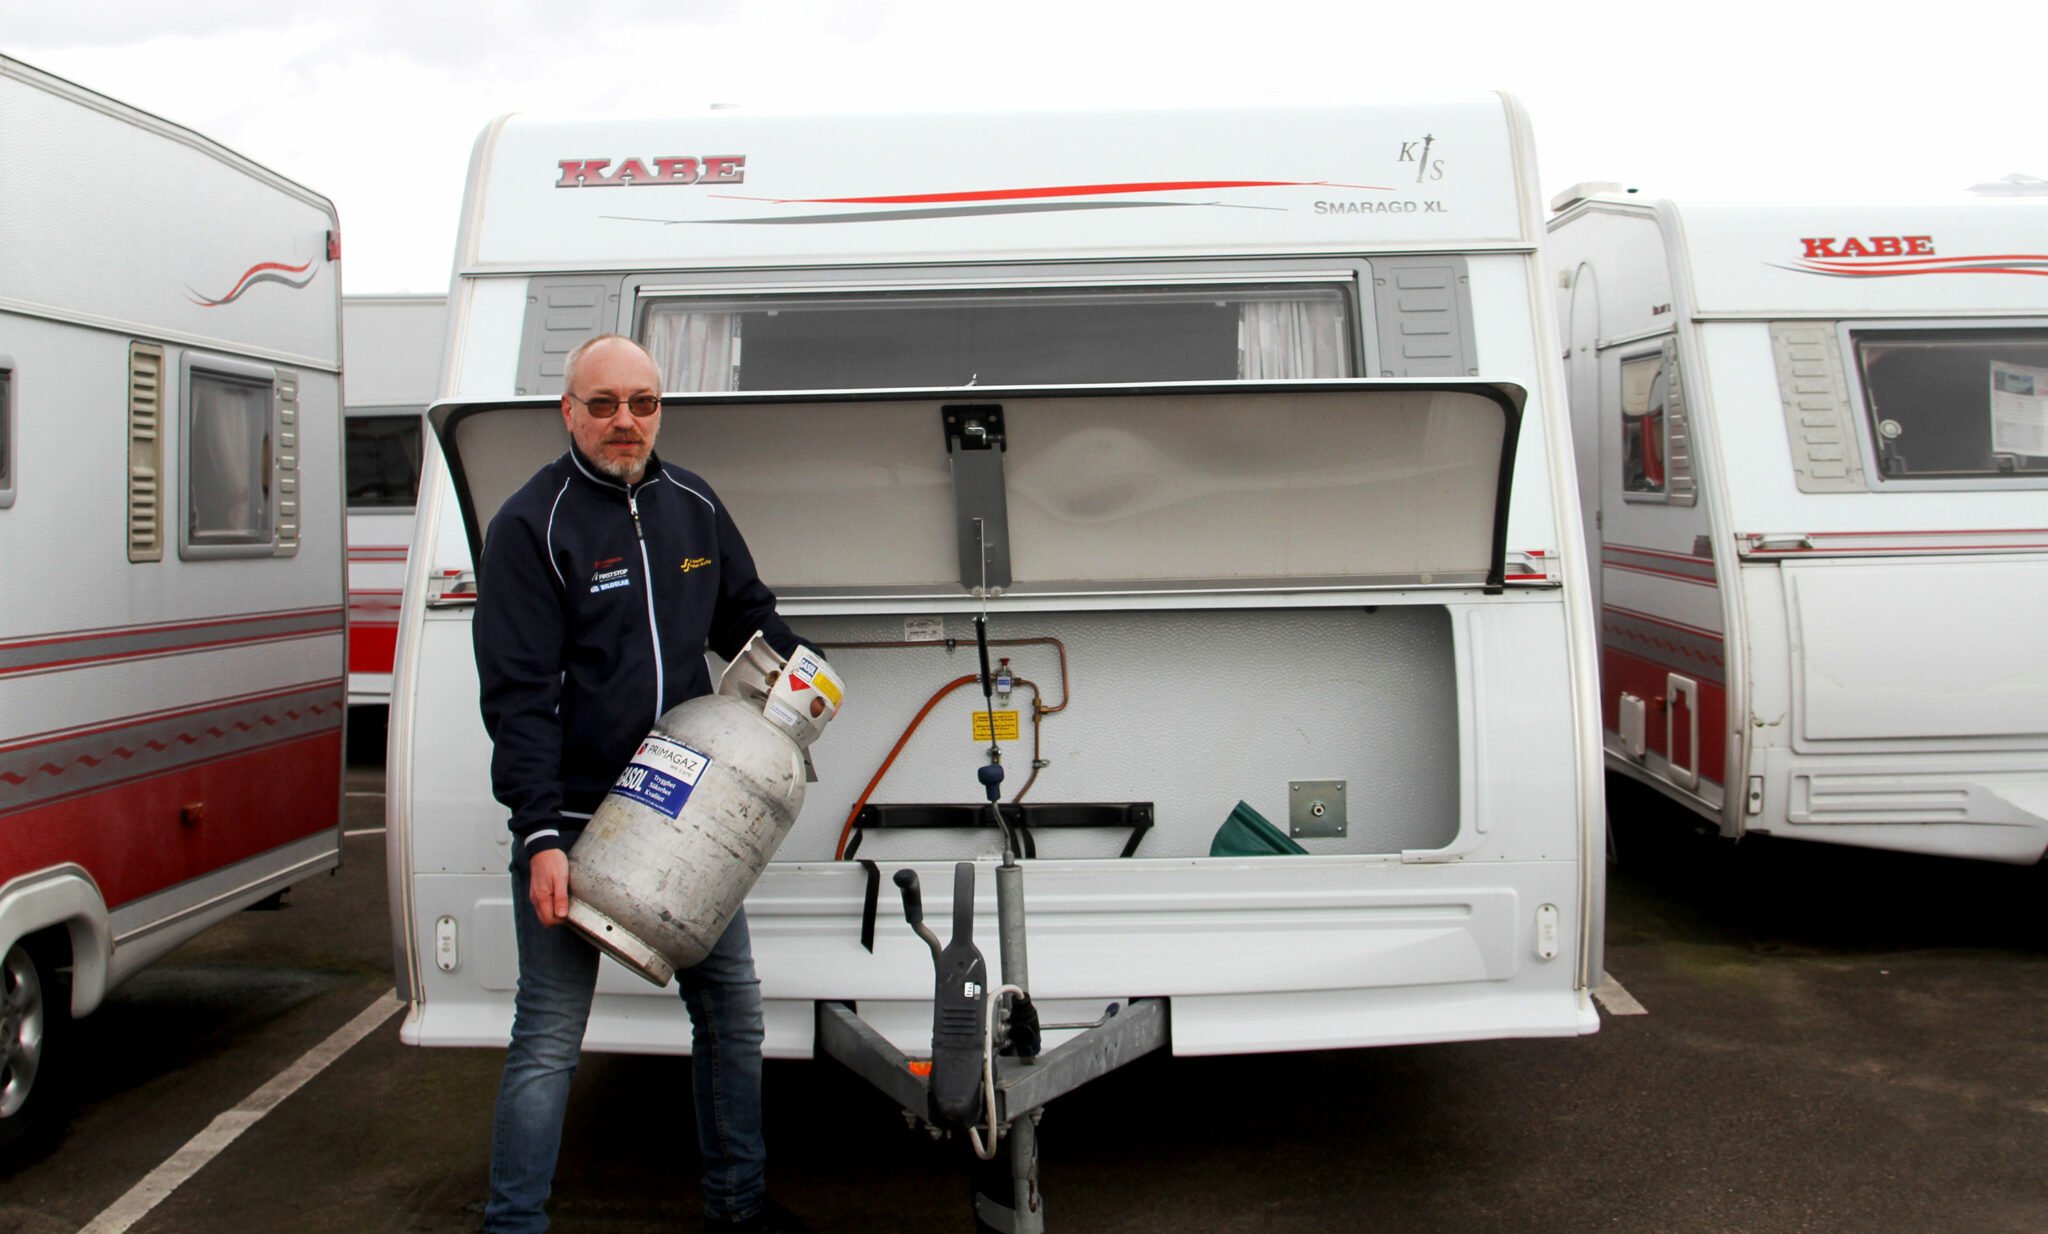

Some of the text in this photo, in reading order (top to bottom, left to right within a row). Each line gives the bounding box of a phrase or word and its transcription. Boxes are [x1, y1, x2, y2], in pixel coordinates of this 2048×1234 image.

[555, 154, 746, 188] KABE
[1313, 200, 1449, 215] SMARAGD XL
[1800, 235, 1936, 258] KABE
[647, 744, 698, 772] PRIMAGAZ
